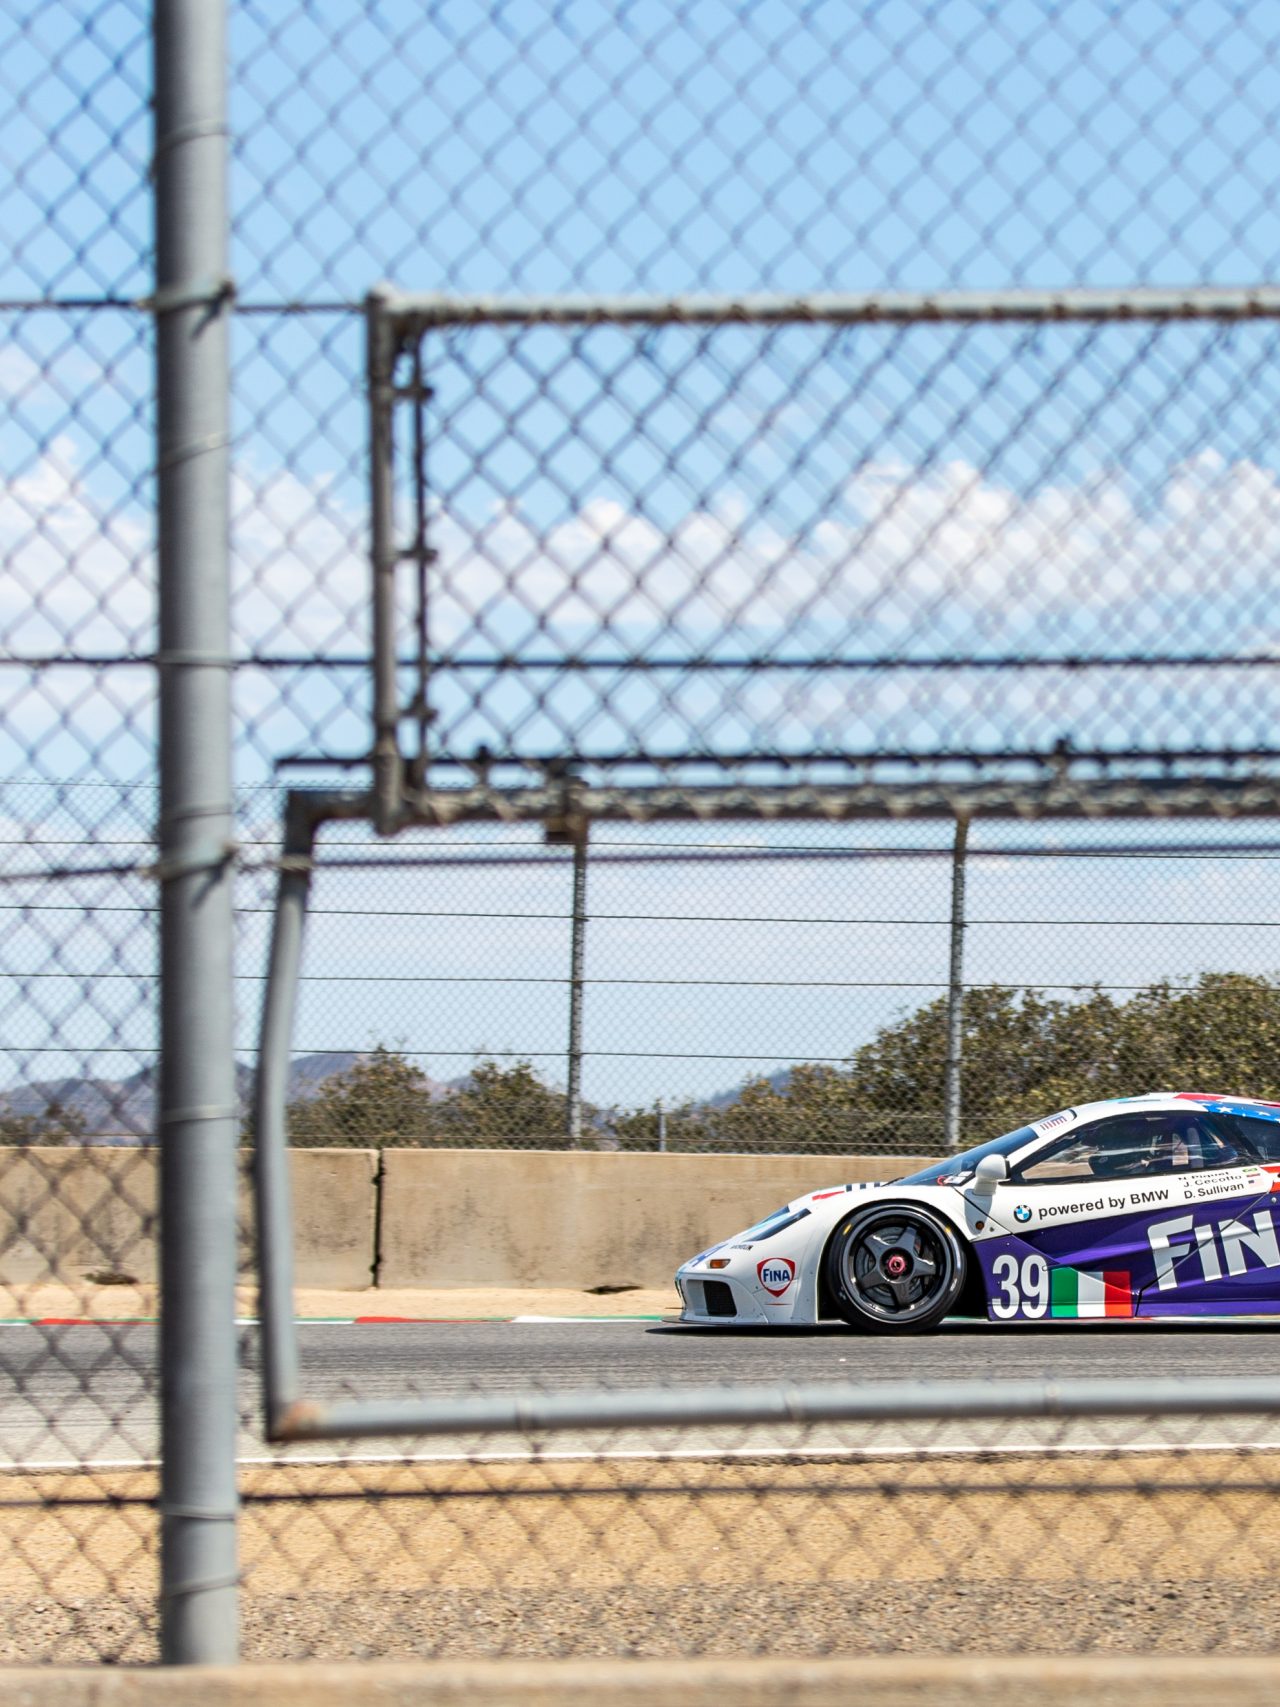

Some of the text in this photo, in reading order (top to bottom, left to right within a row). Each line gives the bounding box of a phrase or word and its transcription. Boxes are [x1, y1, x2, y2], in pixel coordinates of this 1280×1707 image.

[1183, 1183, 1245, 1199] D. Sullivan
[1038, 1199, 1104, 1220] powered
[1108, 1196, 1126, 1210] by
[1130, 1189, 1170, 1205] BMW
[763, 1267, 791, 1283] FINA
[992, 1254, 1050, 1319] 39
